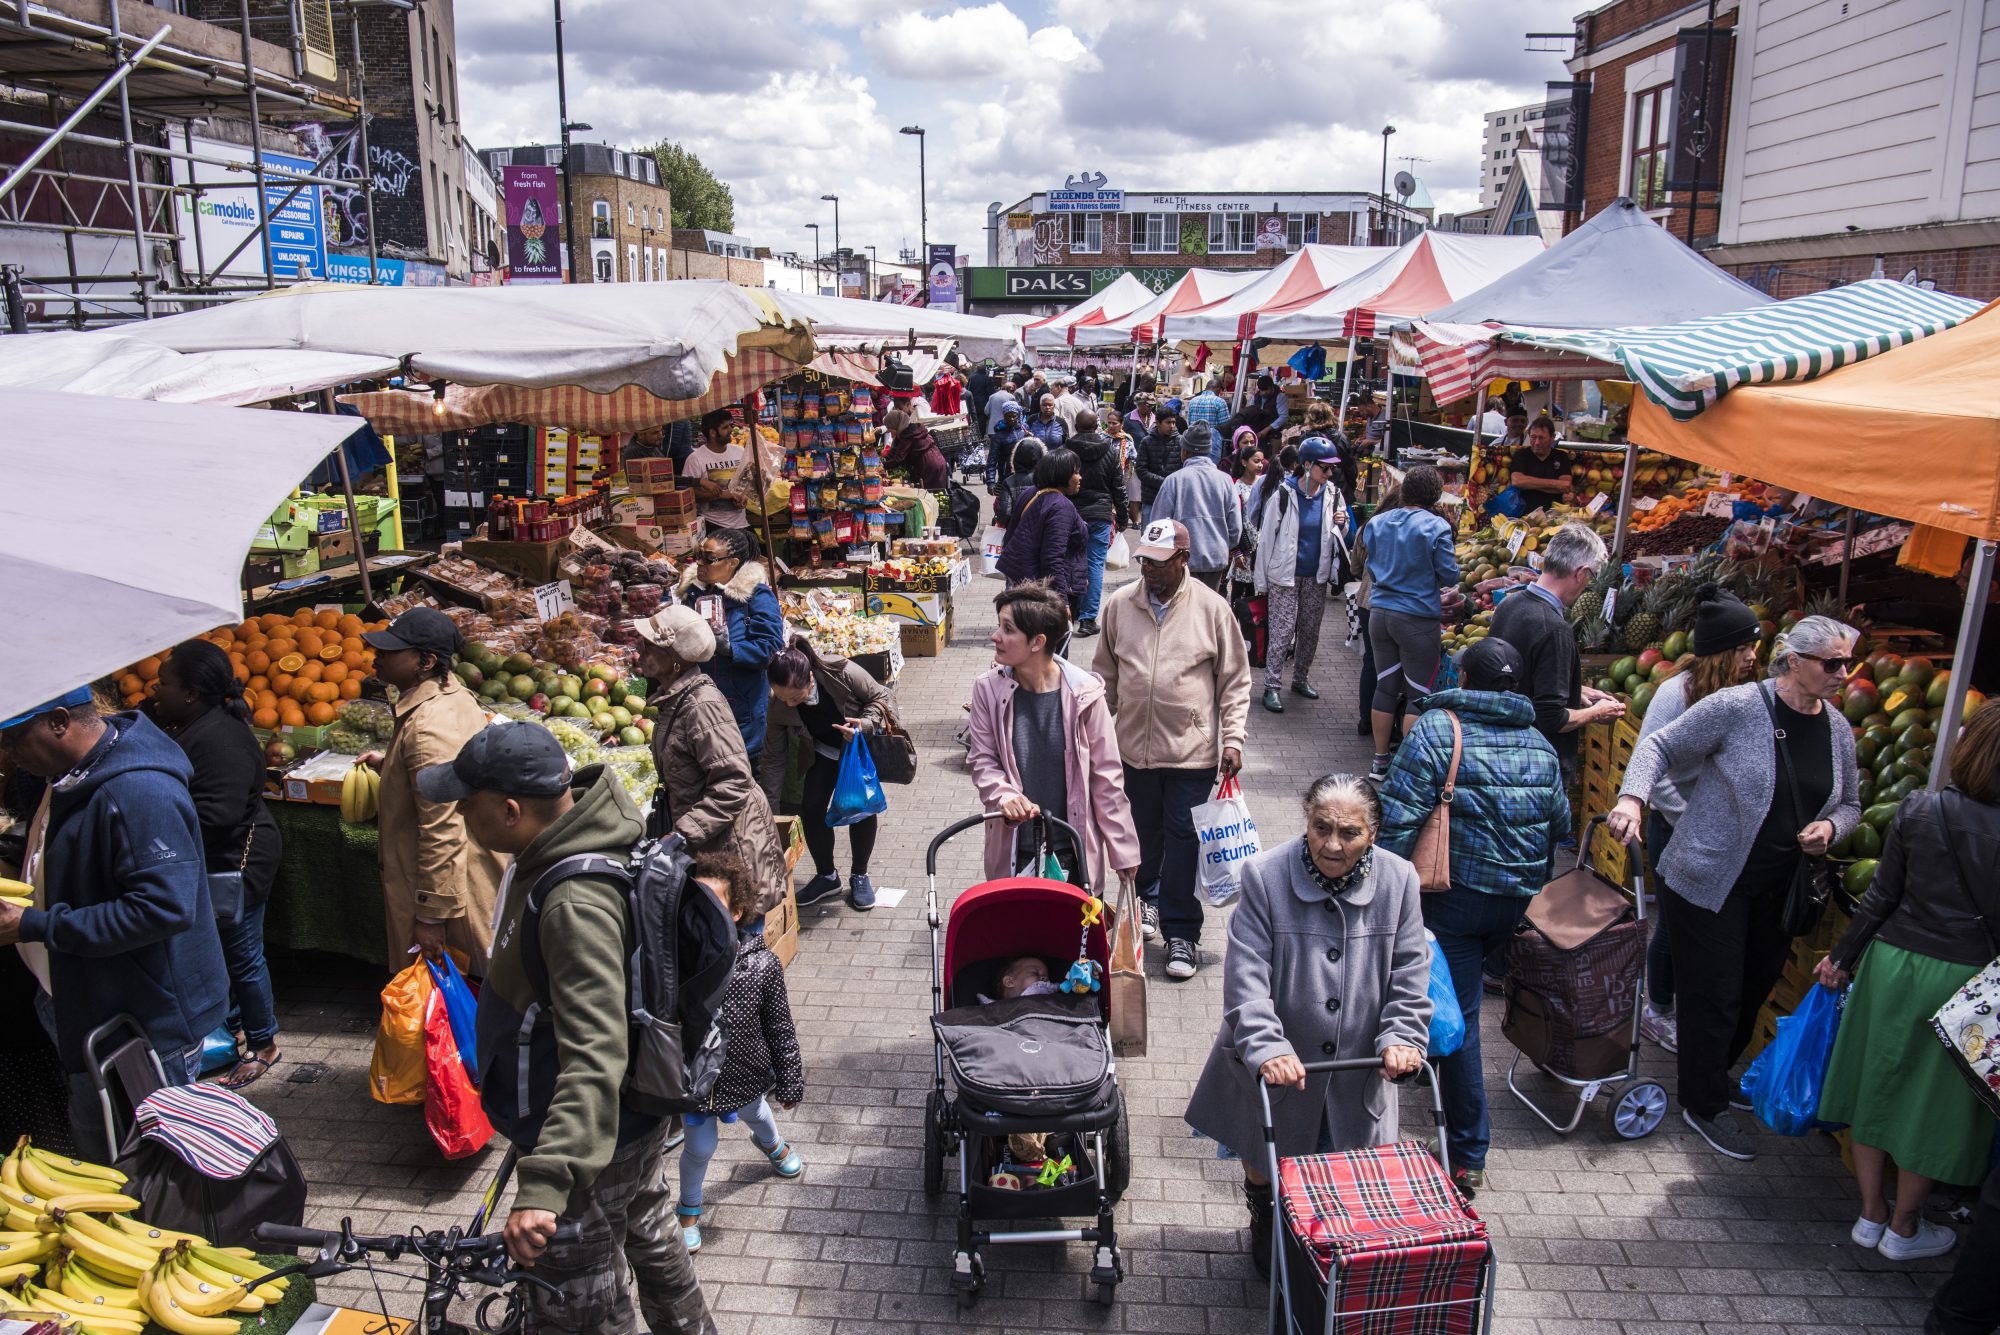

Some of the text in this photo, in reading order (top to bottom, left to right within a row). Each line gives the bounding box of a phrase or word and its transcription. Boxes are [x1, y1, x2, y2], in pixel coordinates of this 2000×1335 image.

[1050, 192, 1120, 200] LEGENDS GYM
[183, 194, 255, 220] Lcamobile
[292, 200, 311, 210] PHONE
[271, 208, 311, 221] CCESSORIES
[280, 230, 304, 240] REPAIRS
[278, 252, 310, 262] UNLOCKING
[805, 370, 820, 382] 50
[706, 460, 734, 470] ALASKA
[1201, 822, 1240, 845] Many
[1206, 842, 1260, 864] returns.
